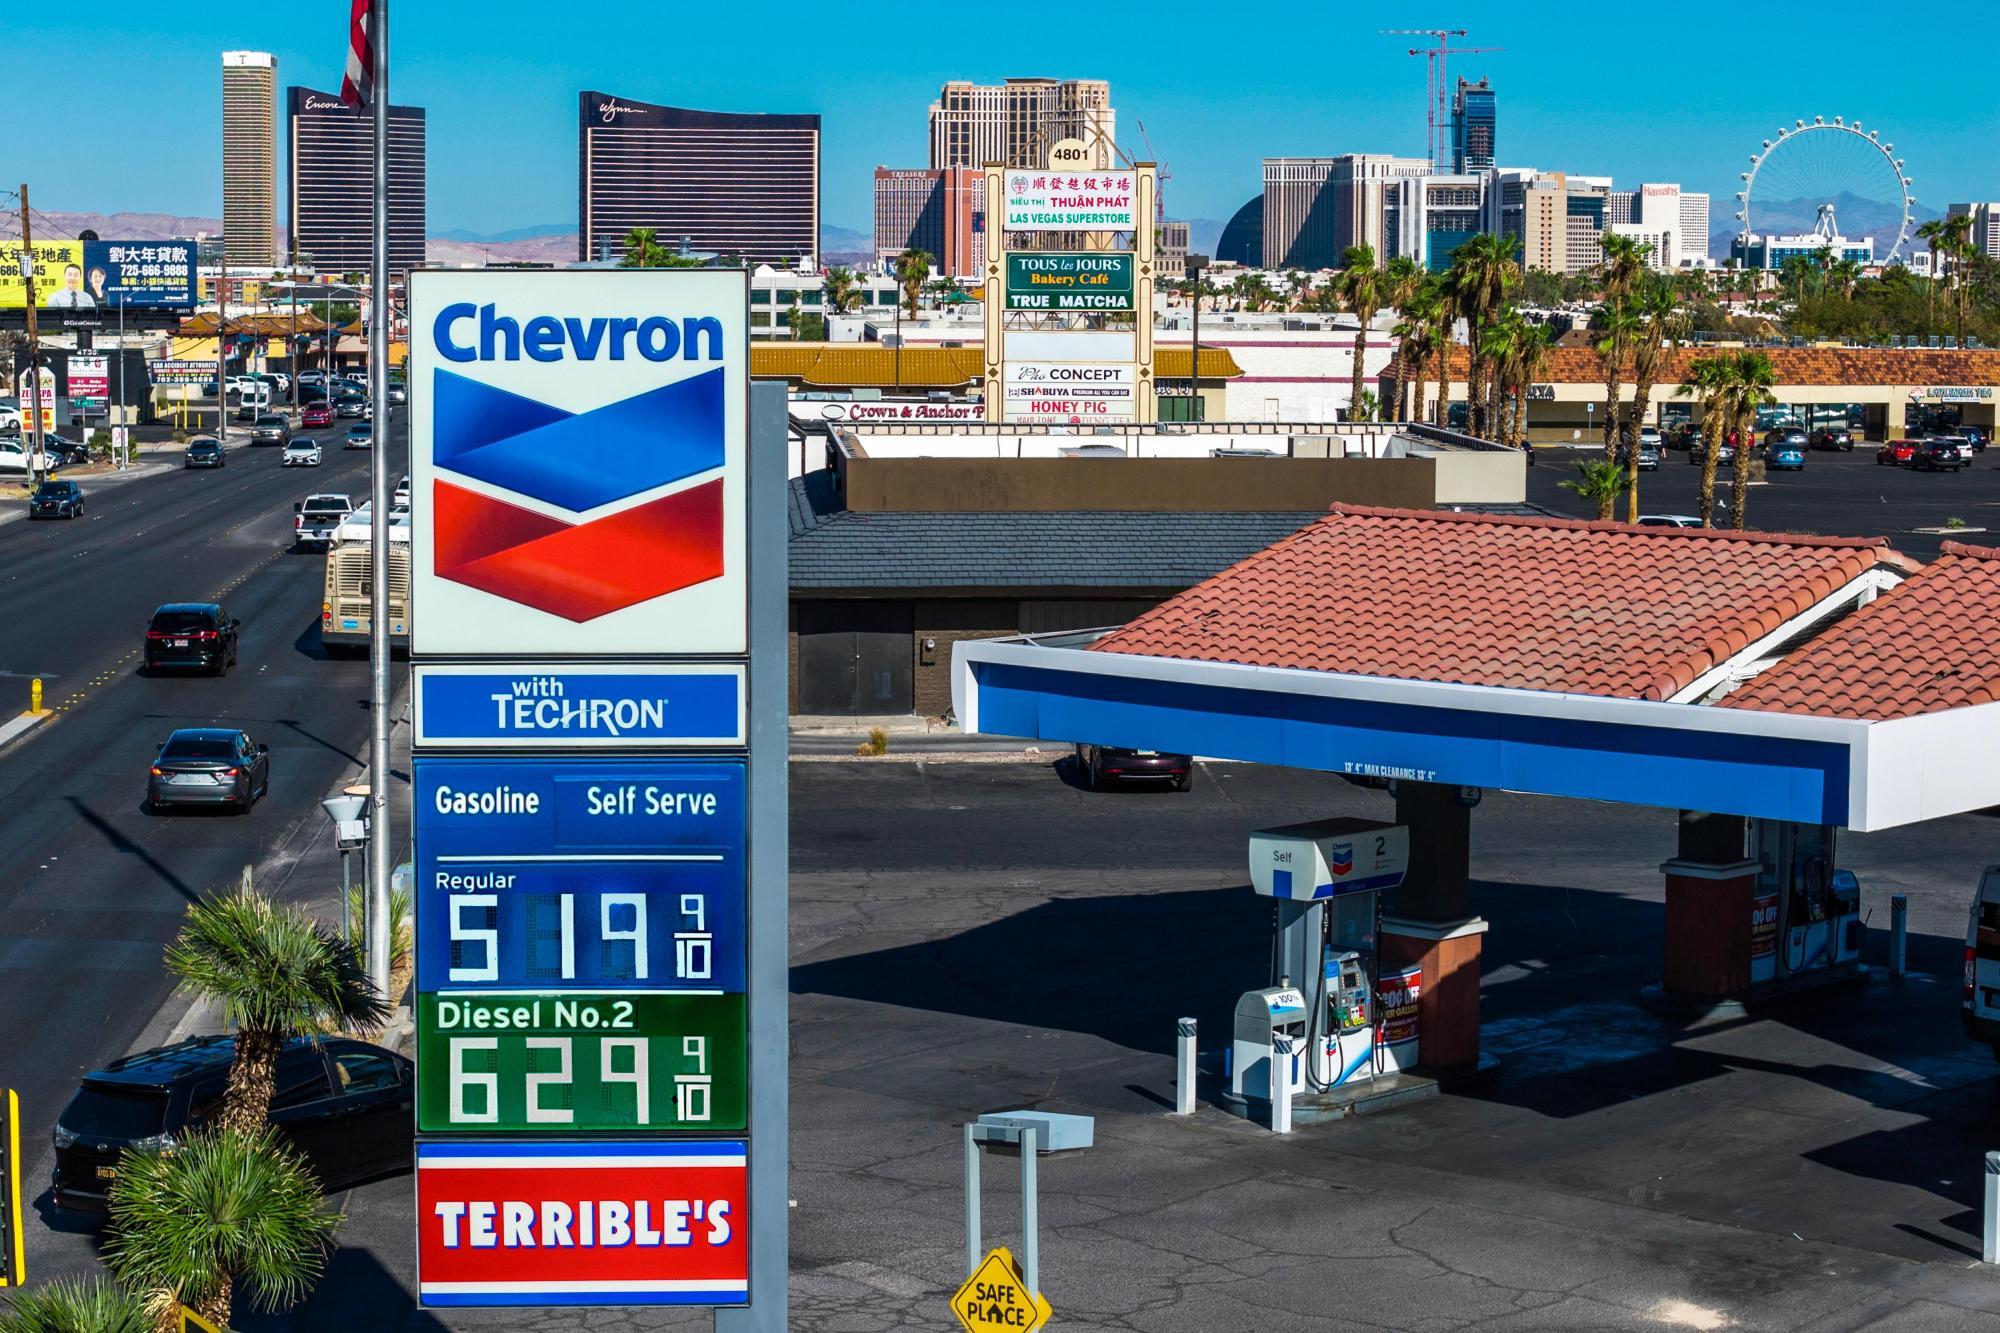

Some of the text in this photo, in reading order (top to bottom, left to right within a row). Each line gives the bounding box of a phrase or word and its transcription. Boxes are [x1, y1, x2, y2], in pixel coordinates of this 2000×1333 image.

[304, 95, 349, 110] Encore
[1053, 148, 1089, 161] 4801
[890, 171, 927, 179] TREASURE
[1050, 194, 1094, 209] THUẬN
[1096, 194, 1130, 208] PHÁT
[1010, 213, 1130, 224] LAS VEGAS SUPERSTORE
[1018, 258, 1122, 272] TOUS les JOURS
[1031, 272, 1109, 287] Bakery Café
[1010, 294, 1128, 308] TRUE MATCHA
[433, 301, 725, 363] Chevron
[1018, 366, 1122, 381] Pho CONCEPT
[1020, 386, 1069, 397] SHABUYA
[849, 403, 898, 420] Crown
[900, 404, 913, 419] &
[915, 403, 970, 419] Anchor
[1031, 401, 1107, 413] HONEY PIG
[511, 676, 564, 697] with
[491, 694, 668, 736] TECHRON
[1364, 763, 1380, 775] MAX
[1380, 764, 1416, 779] CLEARANCE
[435, 785, 717, 815] Gasoline Self Serve
[1375, 836, 1386, 857] 2
[1273, 850, 1292, 864] Self
[435, 872, 516, 893] Regular
[437, 1000, 634, 1029] Diesel No.2
[434, 1199, 731, 1248] TERRIBLE'S
[976, 1282, 1015, 1305] SAFE
